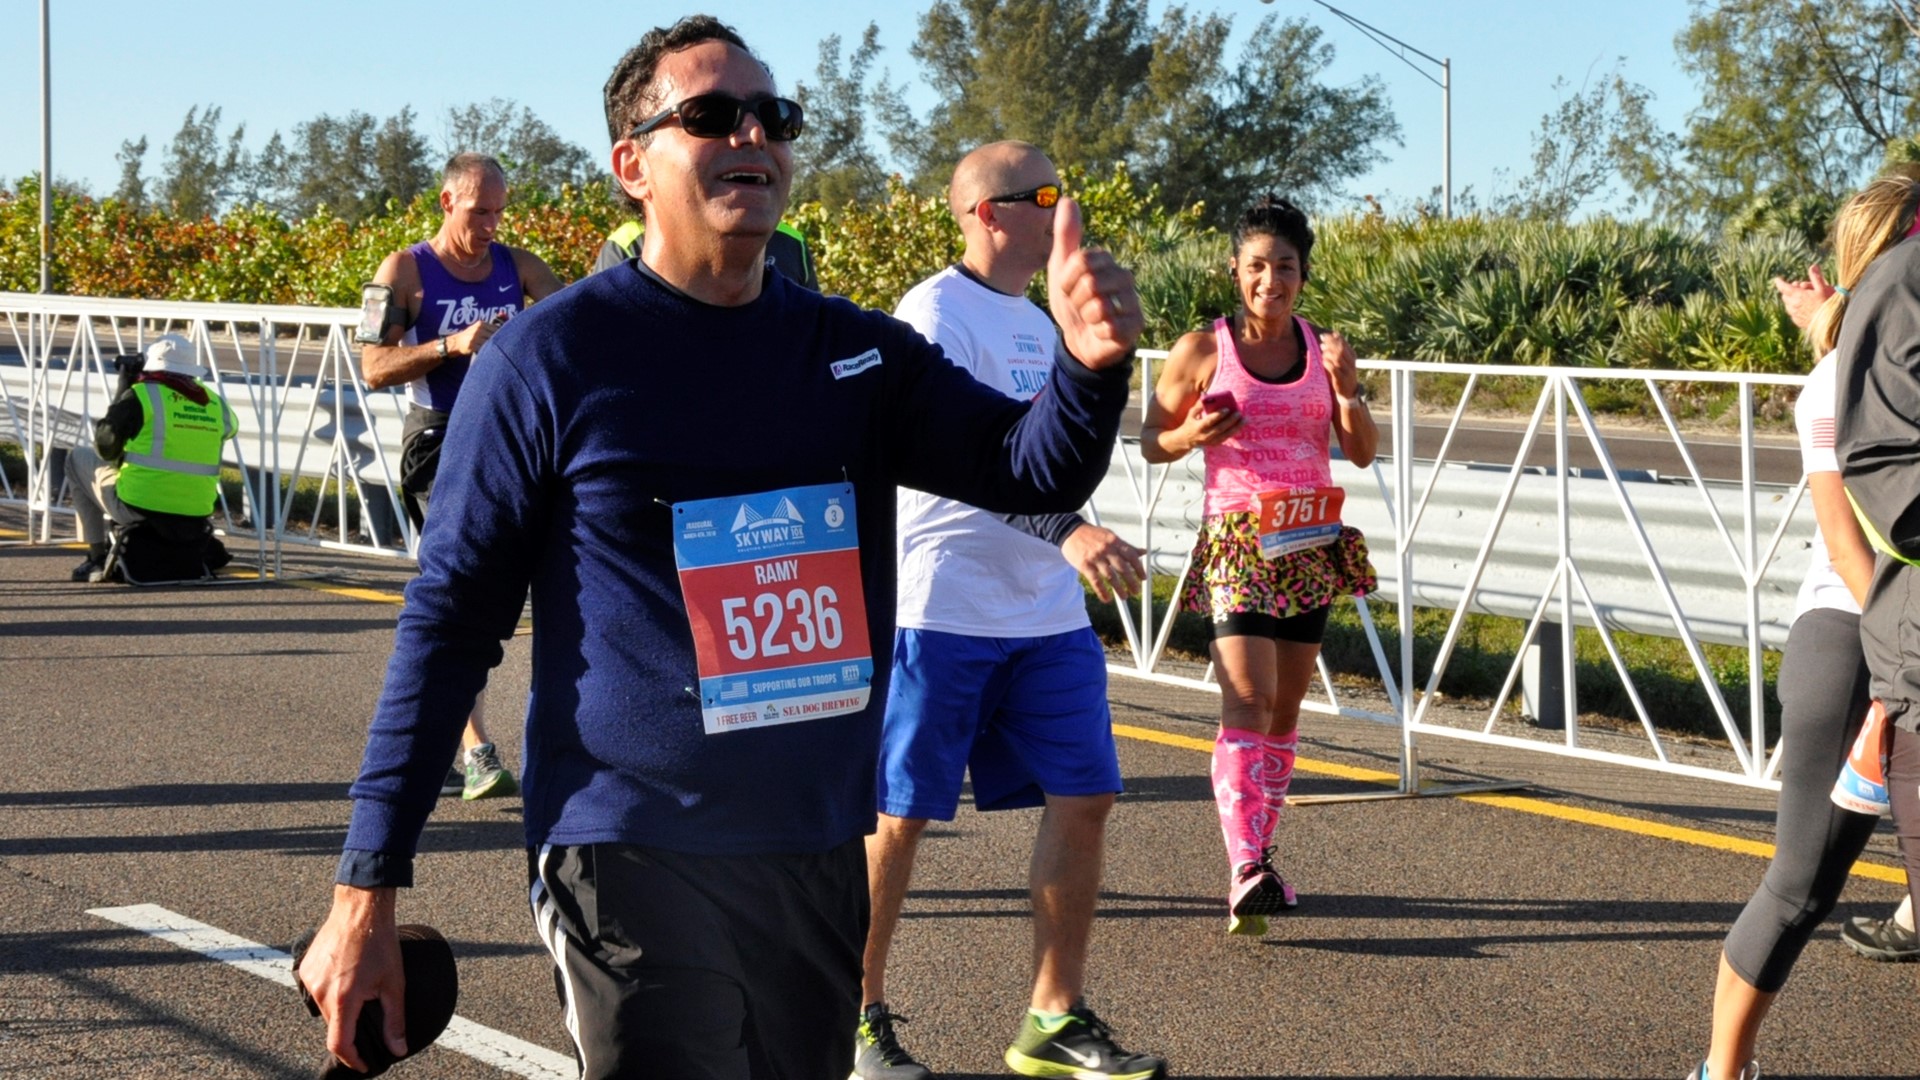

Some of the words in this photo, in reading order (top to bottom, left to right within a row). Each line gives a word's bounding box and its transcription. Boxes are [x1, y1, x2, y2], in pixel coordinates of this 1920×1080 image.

[1011, 369, 1049, 393] SALUT
[173, 411, 217, 423] Photographer
[1242, 401, 1291, 416] ake
[1301, 403, 1325, 420] up
[1239, 448, 1290, 467] your
[1271, 496, 1328, 528] 3751
[735, 526, 789, 547] SKYWAY
[754, 560, 798, 585] RAMY
[721, 585, 843, 660] 5236
[752, 679, 797, 694] SUPPORTING
[797, 676, 812, 688] OUR
[812, 673, 837, 686] TROOPS
[783, 706, 800, 716] SEA
[802, 703, 820, 714] DOG
[821, 697, 860, 711] BREWING
[721, 713, 739, 726] FREE
[740, 711, 757, 723] BEER
